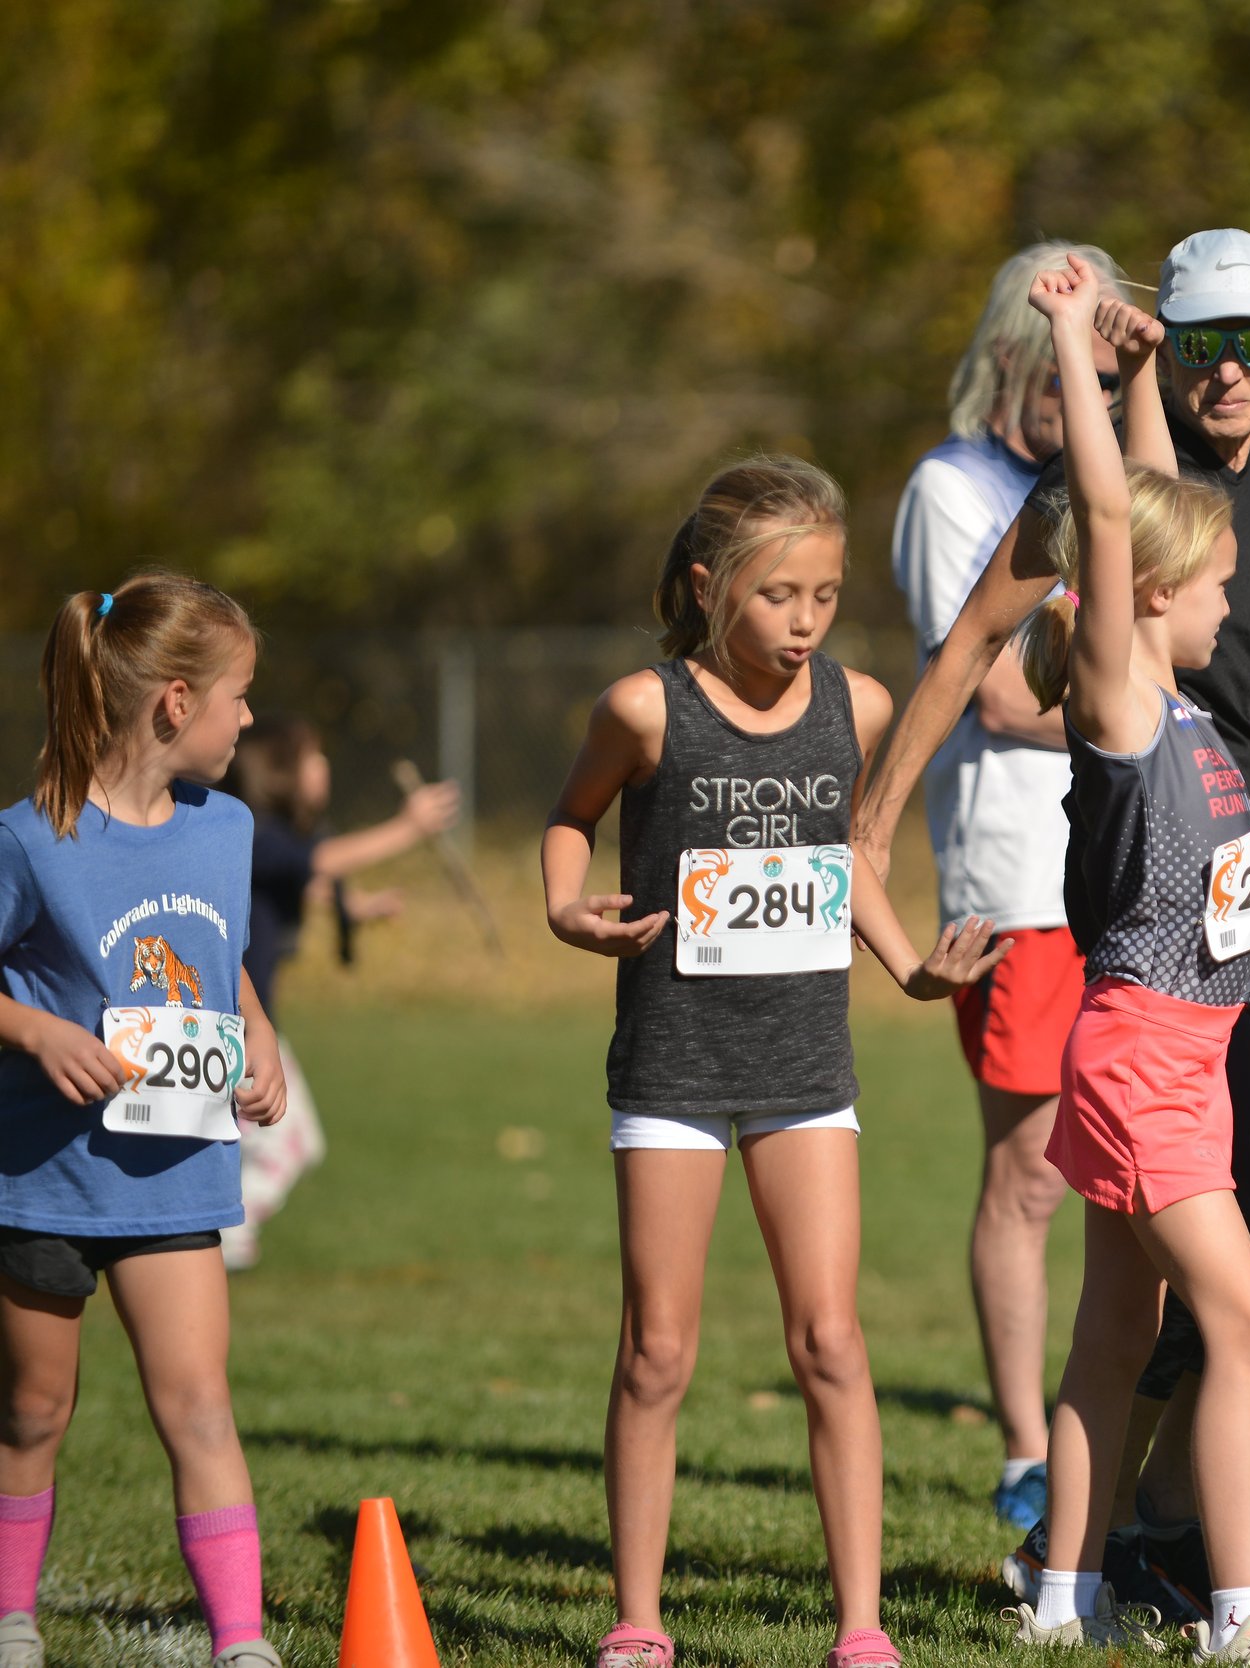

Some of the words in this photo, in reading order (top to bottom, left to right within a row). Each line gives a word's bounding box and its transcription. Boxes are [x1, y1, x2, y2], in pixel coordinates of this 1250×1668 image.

[689, 773, 842, 814] STRONG
[726, 813, 807, 849] GIRL
[100, 898, 159, 958] Colorado
[161, 892, 228, 941] Lightning
[727, 880, 815, 931] 284
[145, 1043, 228, 1094] 290
